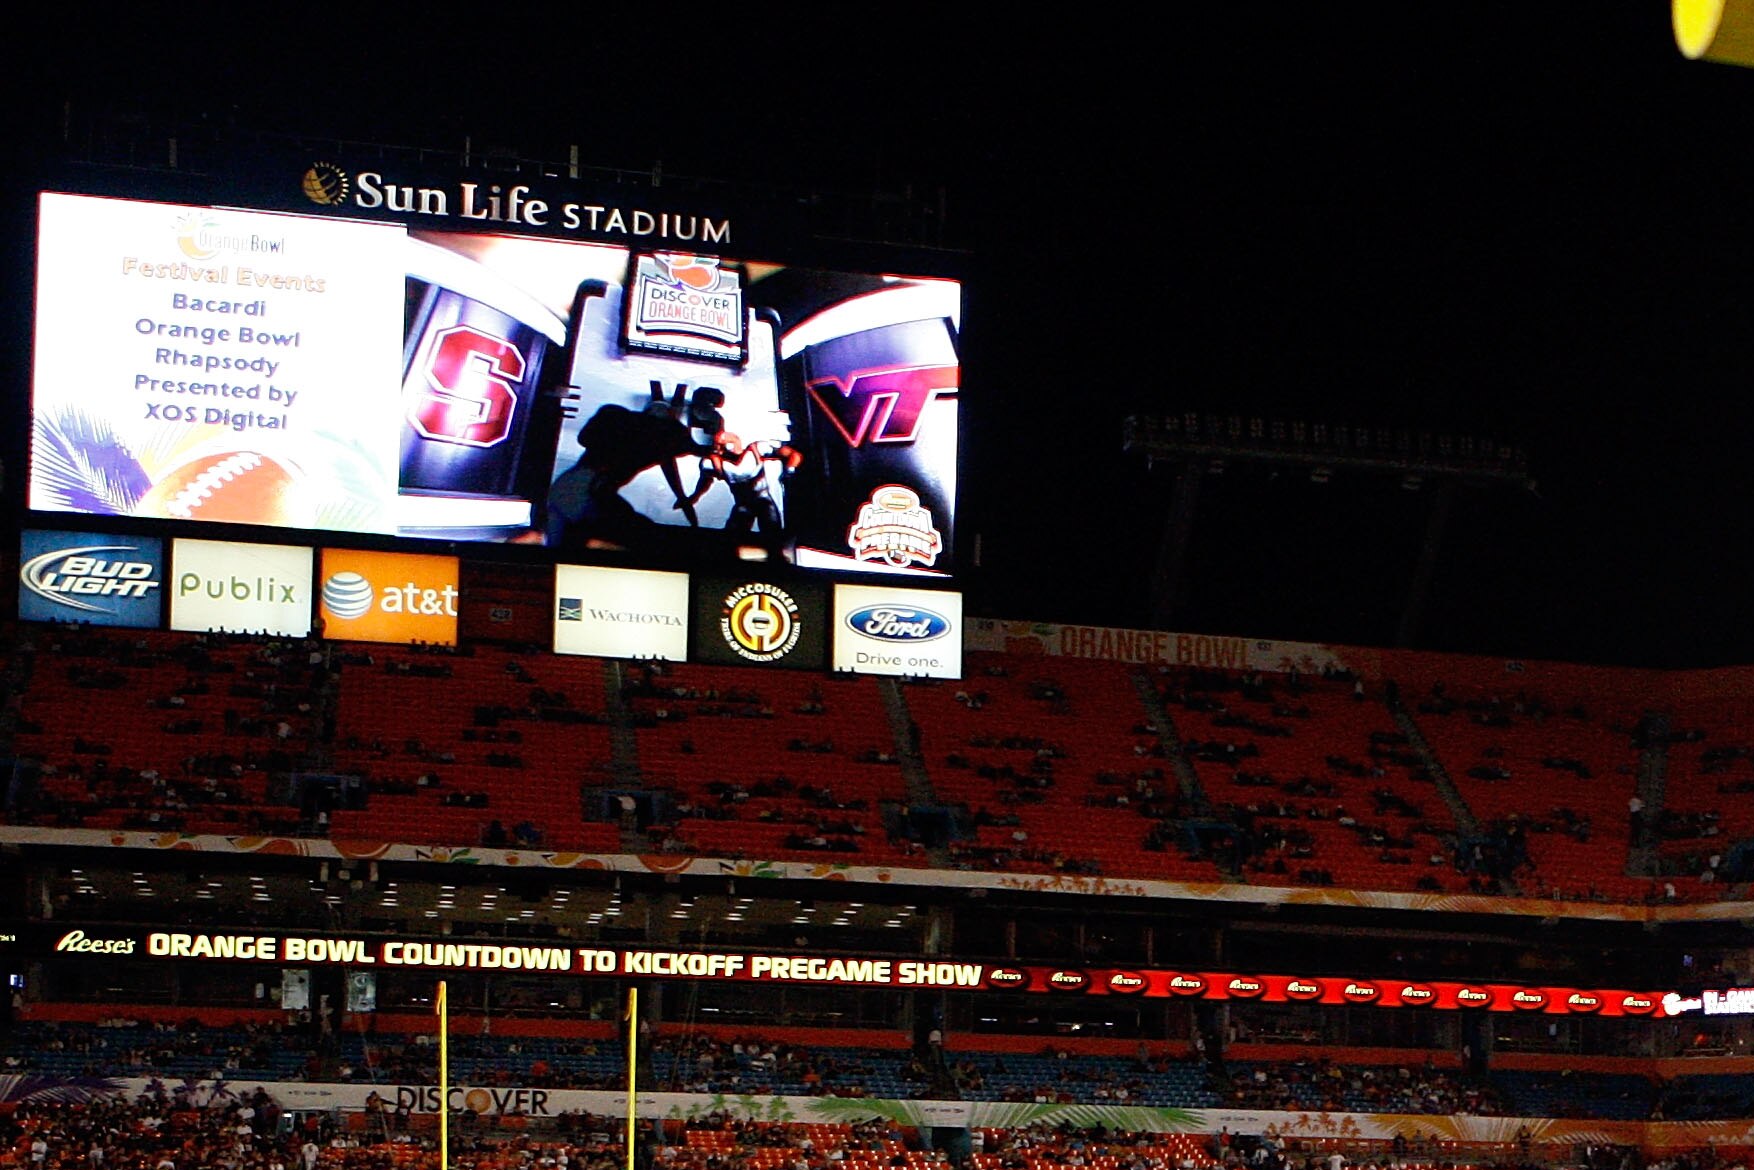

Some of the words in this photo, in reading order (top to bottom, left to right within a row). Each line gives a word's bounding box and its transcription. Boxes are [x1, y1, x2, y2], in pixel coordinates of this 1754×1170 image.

[355, 172, 448, 215] Sun
[460, 182, 548, 227] Life
[563, 203, 732, 244] STADIUM
[122, 257, 229, 284] Festival
[236, 266, 326, 292] Events
[173, 293, 267, 316] Bacardi
[651, 287, 730, 310] DISCOVER
[649, 301, 696, 321] ORANGE
[700, 309, 731, 330] BOWL
[135, 318, 230, 345] Orange
[238, 327, 300, 347] Bowl
[155, 348, 280, 378] Rhapsody
[134, 374, 261, 400] Presented
[268, 385, 298, 407] by
[144, 402, 198, 423] XOS
[203, 408, 288, 431] Digital
[60, 556, 154, 580] BUD
[40, 577, 159, 598] LIGHT
[180, 572, 296, 604] Publix
[380, 581, 459, 617] at&t
[865, 605, 930, 638] Ford
[855, 651, 900, 668] Drive
[908, 655, 944, 669] one.
[1060, 625, 1170, 664] ORANGE
[1176, 633, 1256, 671] BOWL
[57, 929, 137, 954] Reese's
[148, 932, 276, 960] ORANGE
[284, 937, 375, 964] BOWL
[384, 942, 571, 970] COUNTDOWN
[579, 948, 616, 972] TO
[625, 951, 743, 977] KICKOFF
[751, 956, 891, 983] PREGAME
[898, 961, 983, 987] SHOW
[398, 1086, 549, 1115] DISCOVER
